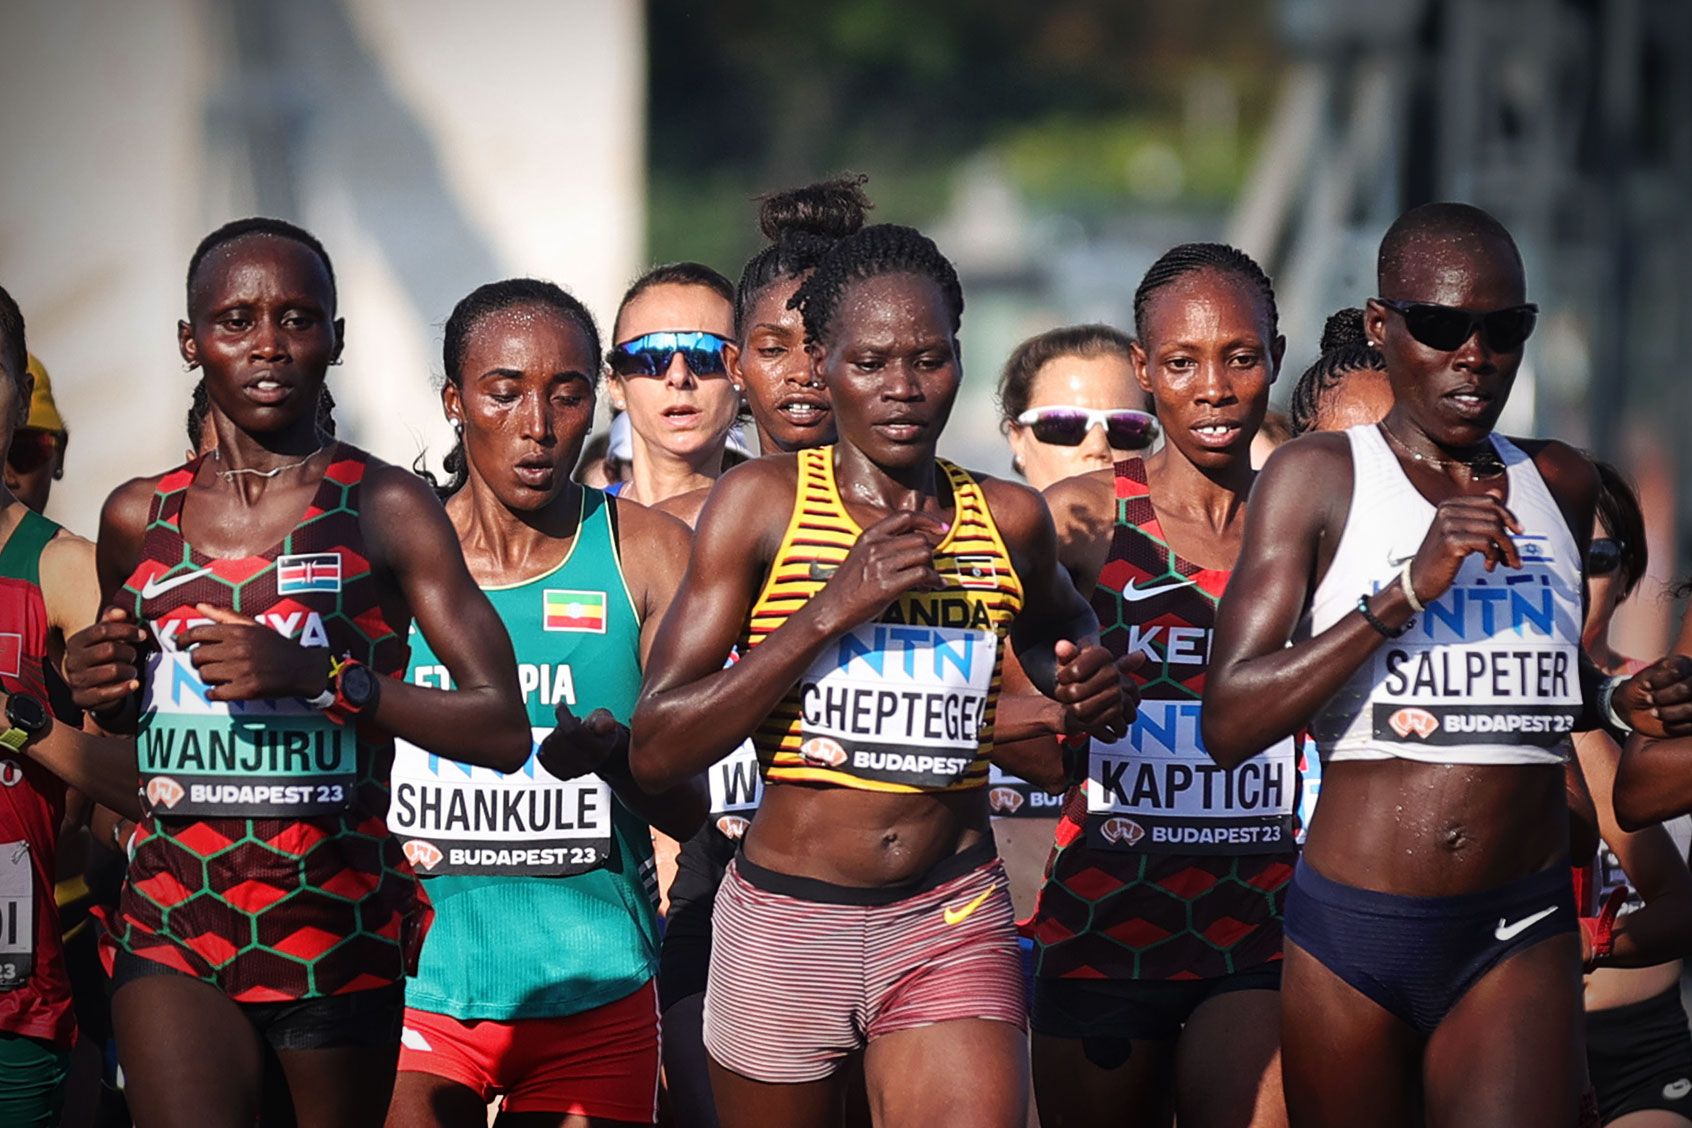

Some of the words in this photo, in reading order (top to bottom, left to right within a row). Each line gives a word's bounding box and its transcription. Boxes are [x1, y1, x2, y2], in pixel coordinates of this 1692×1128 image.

[876, 598, 992, 629] ANDA
[1423, 588, 1554, 638] NTN
[838, 626, 974, 684] NTN
[1386, 651, 1568, 698] SALPETER
[415, 664, 576, 705] ETPIA
[1443, 714, 1554, 733] BUDAPEST
[1554, 715, 1575, 732] 23
[145, 729, 342, 772] WANJIRU
[854, 751, 967, 775] BUDAPEST
[190, 784, 313, 804] BUDAPEST
[317, 785, 344, 803] 23
[1102, 761, 1283, 809] KAPTICH
[396, 782, 599, 830] SHANKULE
[1152, 826, 1260, 844] BUDAPEST
[1262, 825, 1281, 842] 23
[449, 847, 567, 866] BUDAPEST
[570, 847, 597, 864] 23
